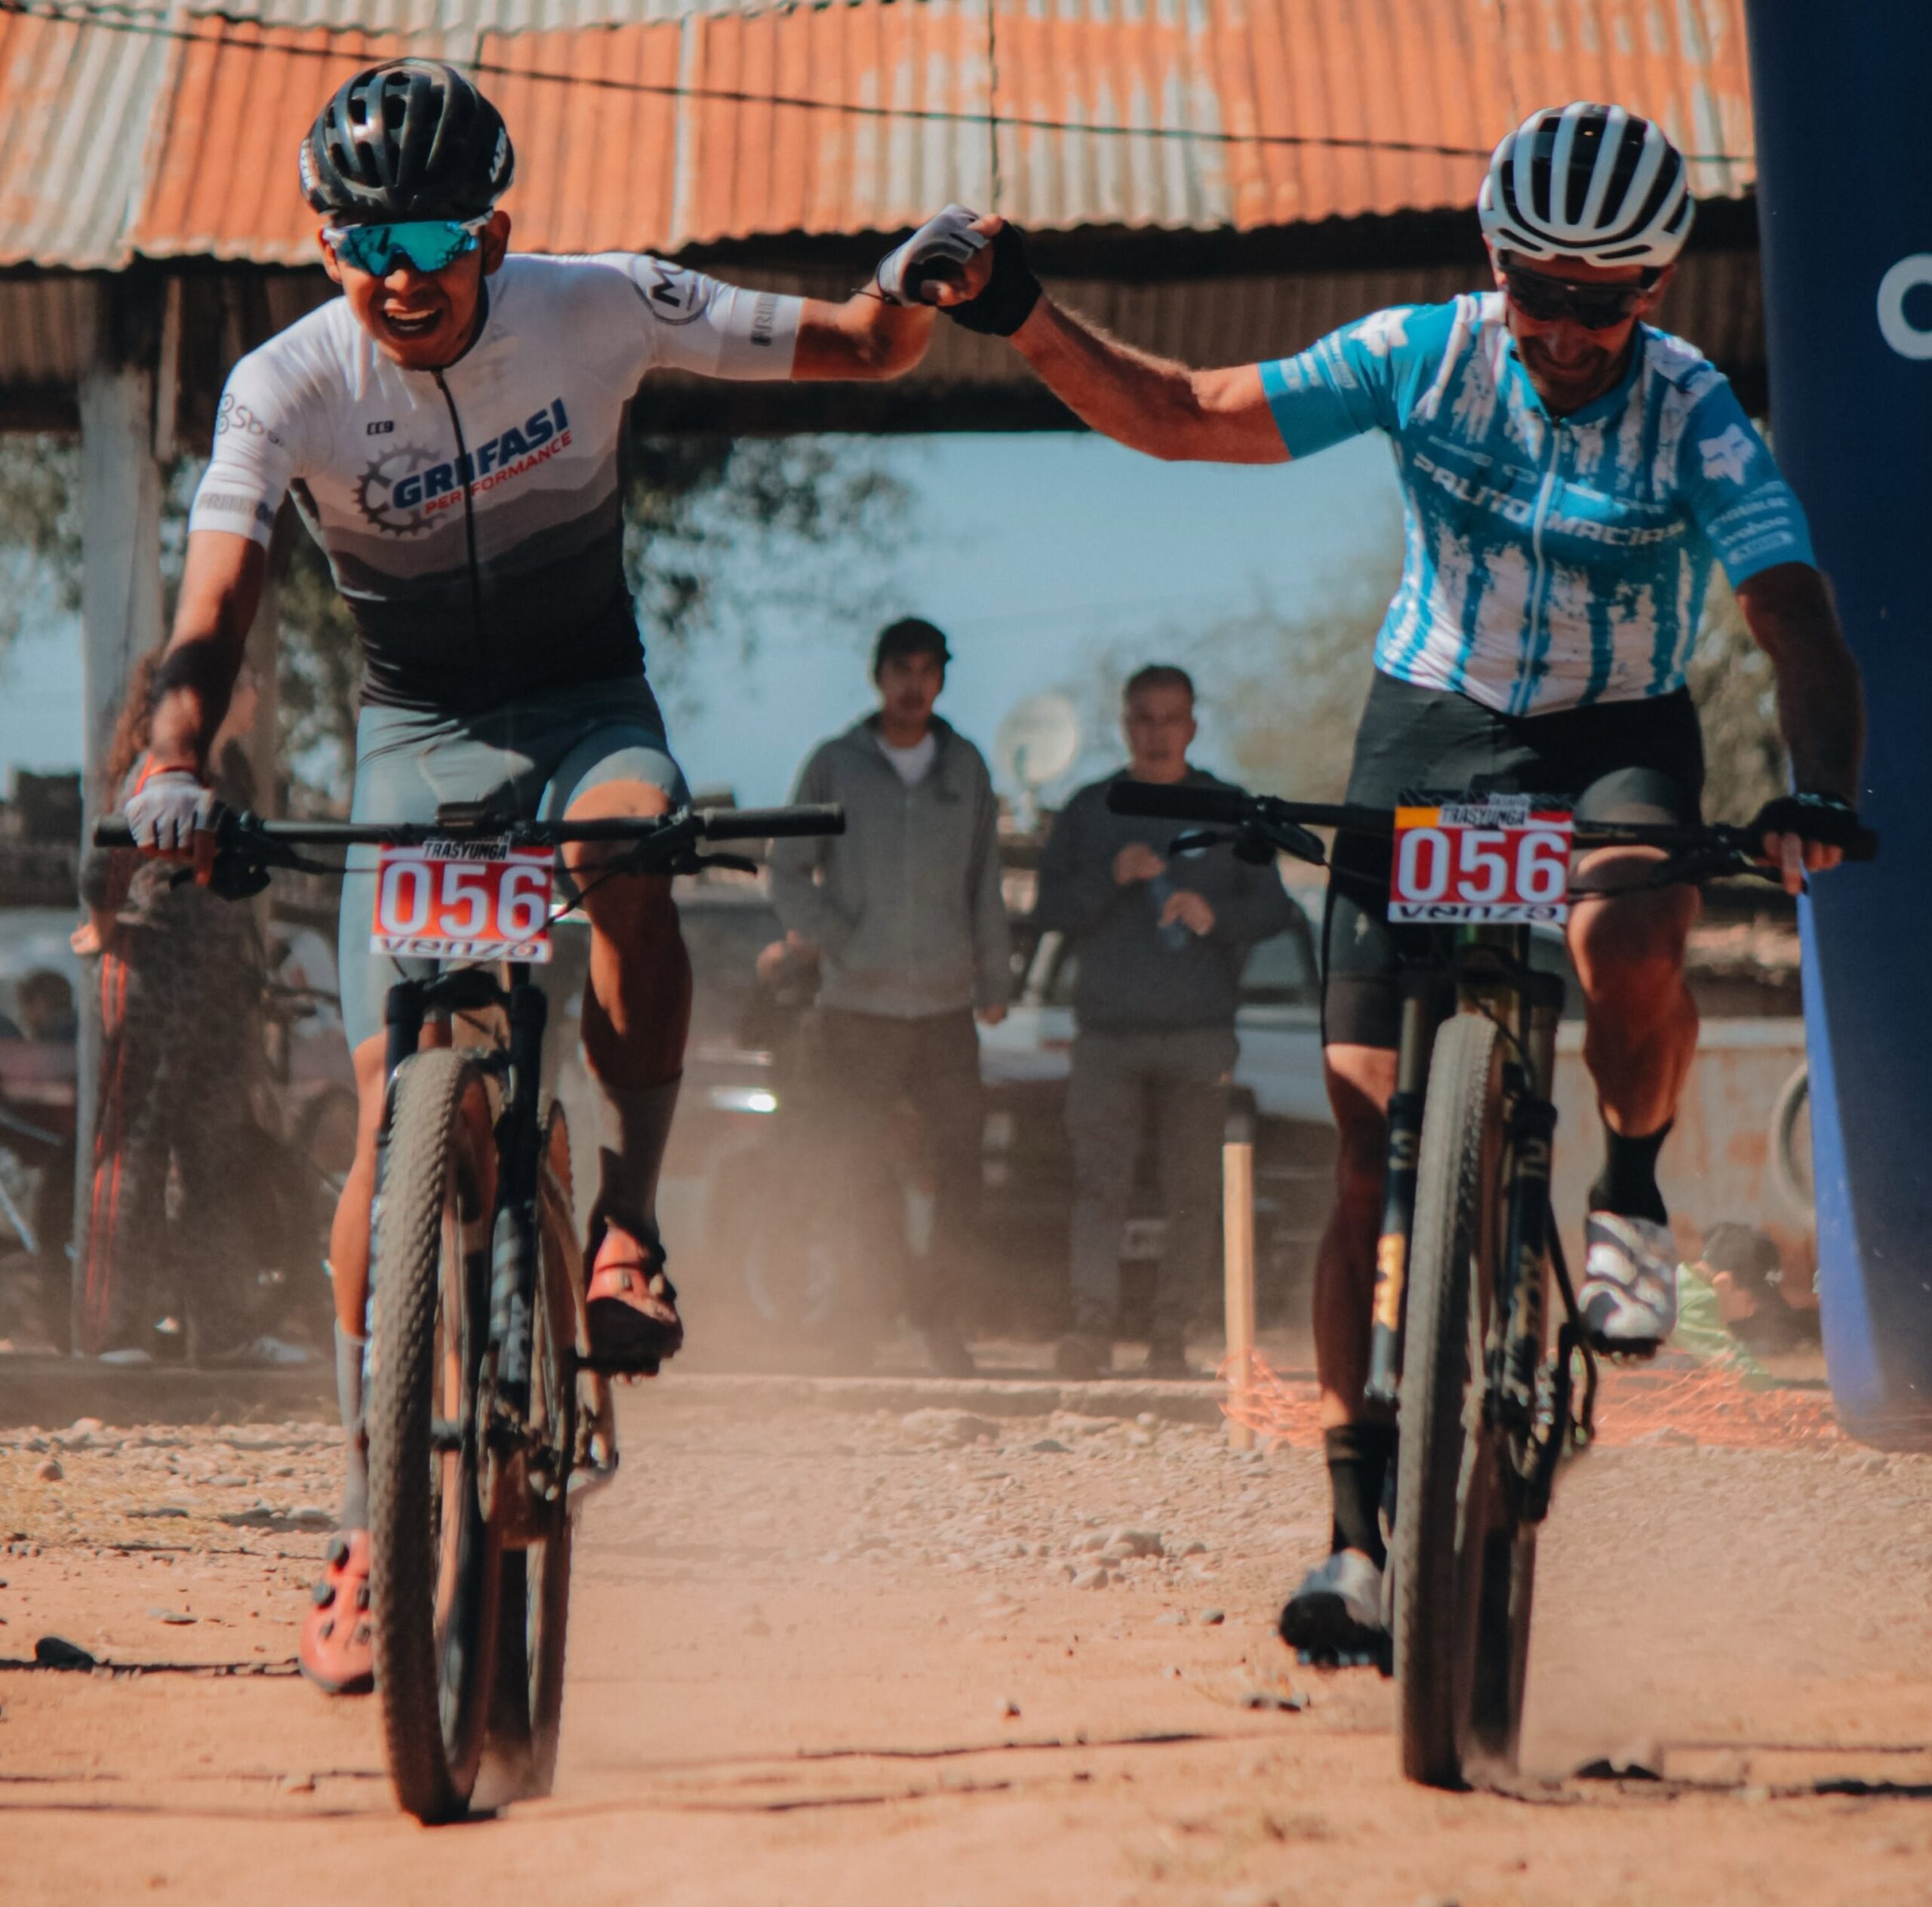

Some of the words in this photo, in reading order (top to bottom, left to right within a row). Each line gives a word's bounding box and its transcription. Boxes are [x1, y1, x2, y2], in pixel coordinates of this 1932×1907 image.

[392, 397, 569, 509] GRIFASI
[424, 429, 572, 515] PERFORMANCE
[423, 841, 508, 860] TRASYUNGA
[1398, 828, 1567, 903] 056
[380, 862, 547, 940] 056
